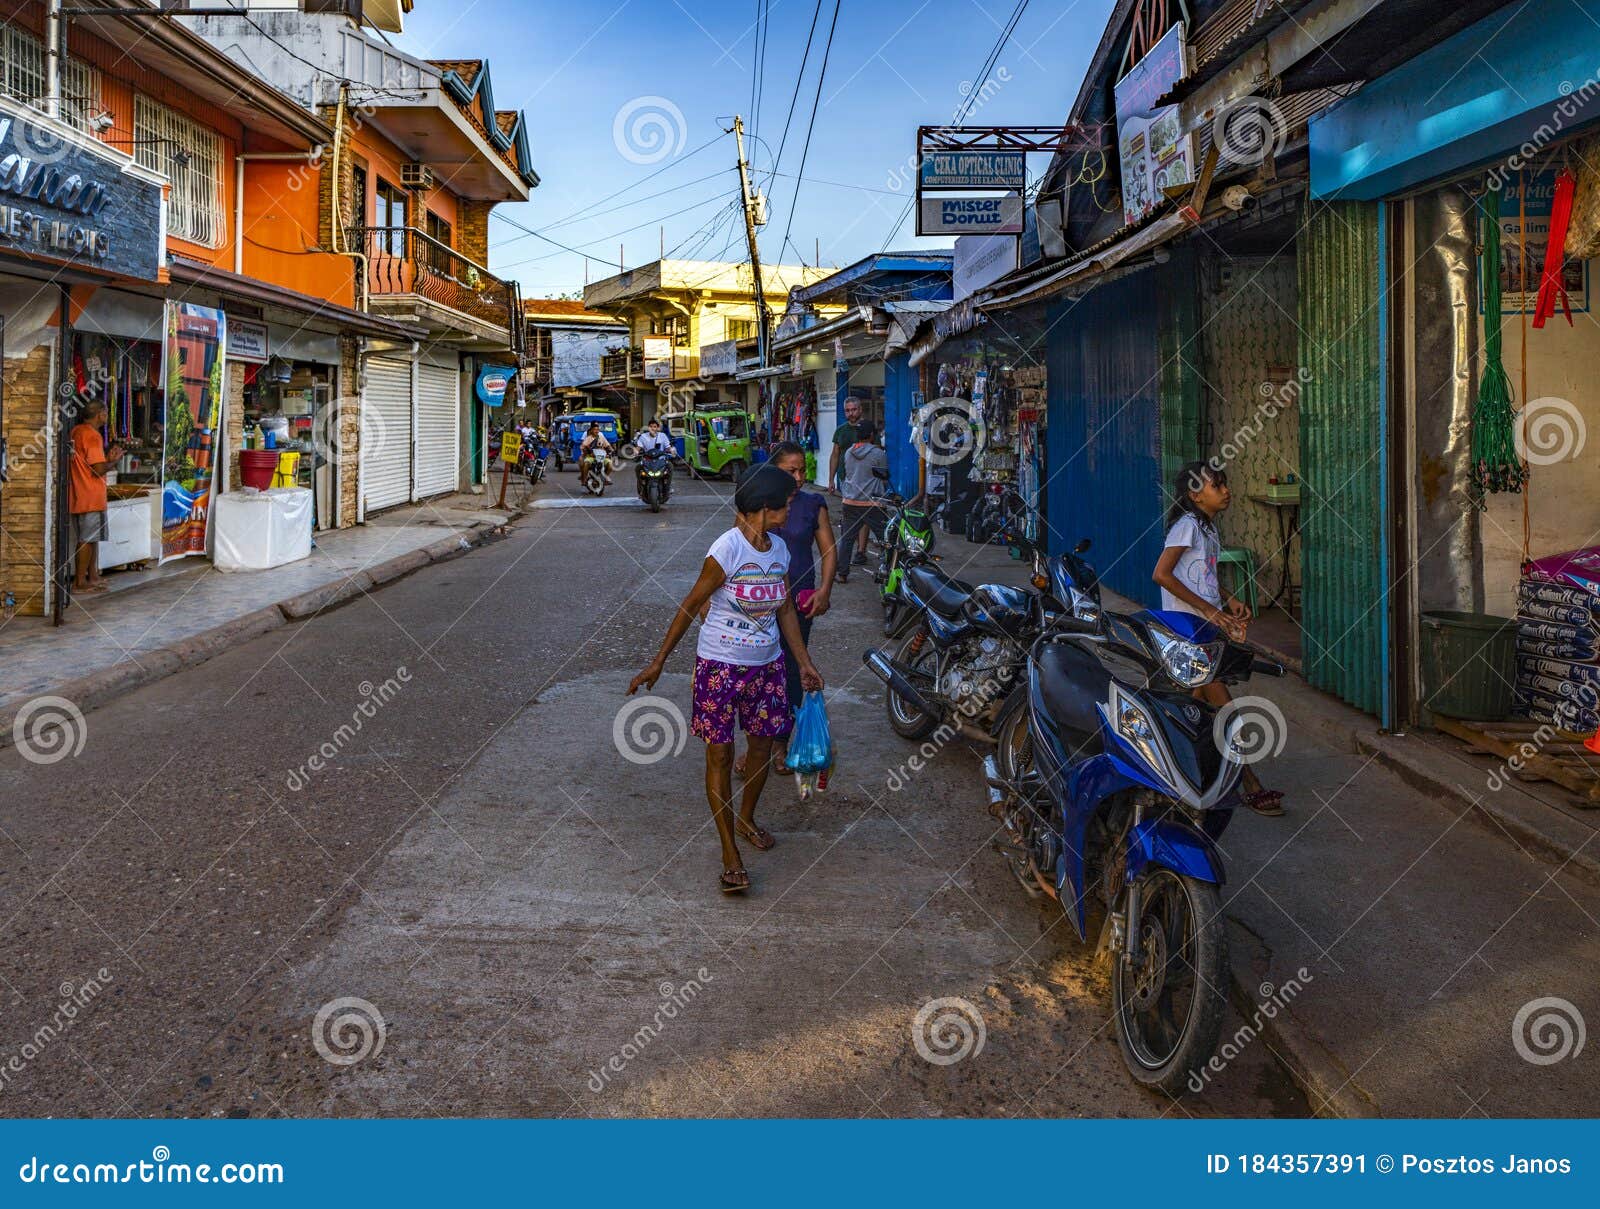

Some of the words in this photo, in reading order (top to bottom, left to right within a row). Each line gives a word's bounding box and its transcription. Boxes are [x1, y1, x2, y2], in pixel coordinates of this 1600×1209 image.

[958, 156, 993, 175] OPTICAL
[995, 156, 1022, 175] CLINIC
[942, 213, 1002, 224] Donut
